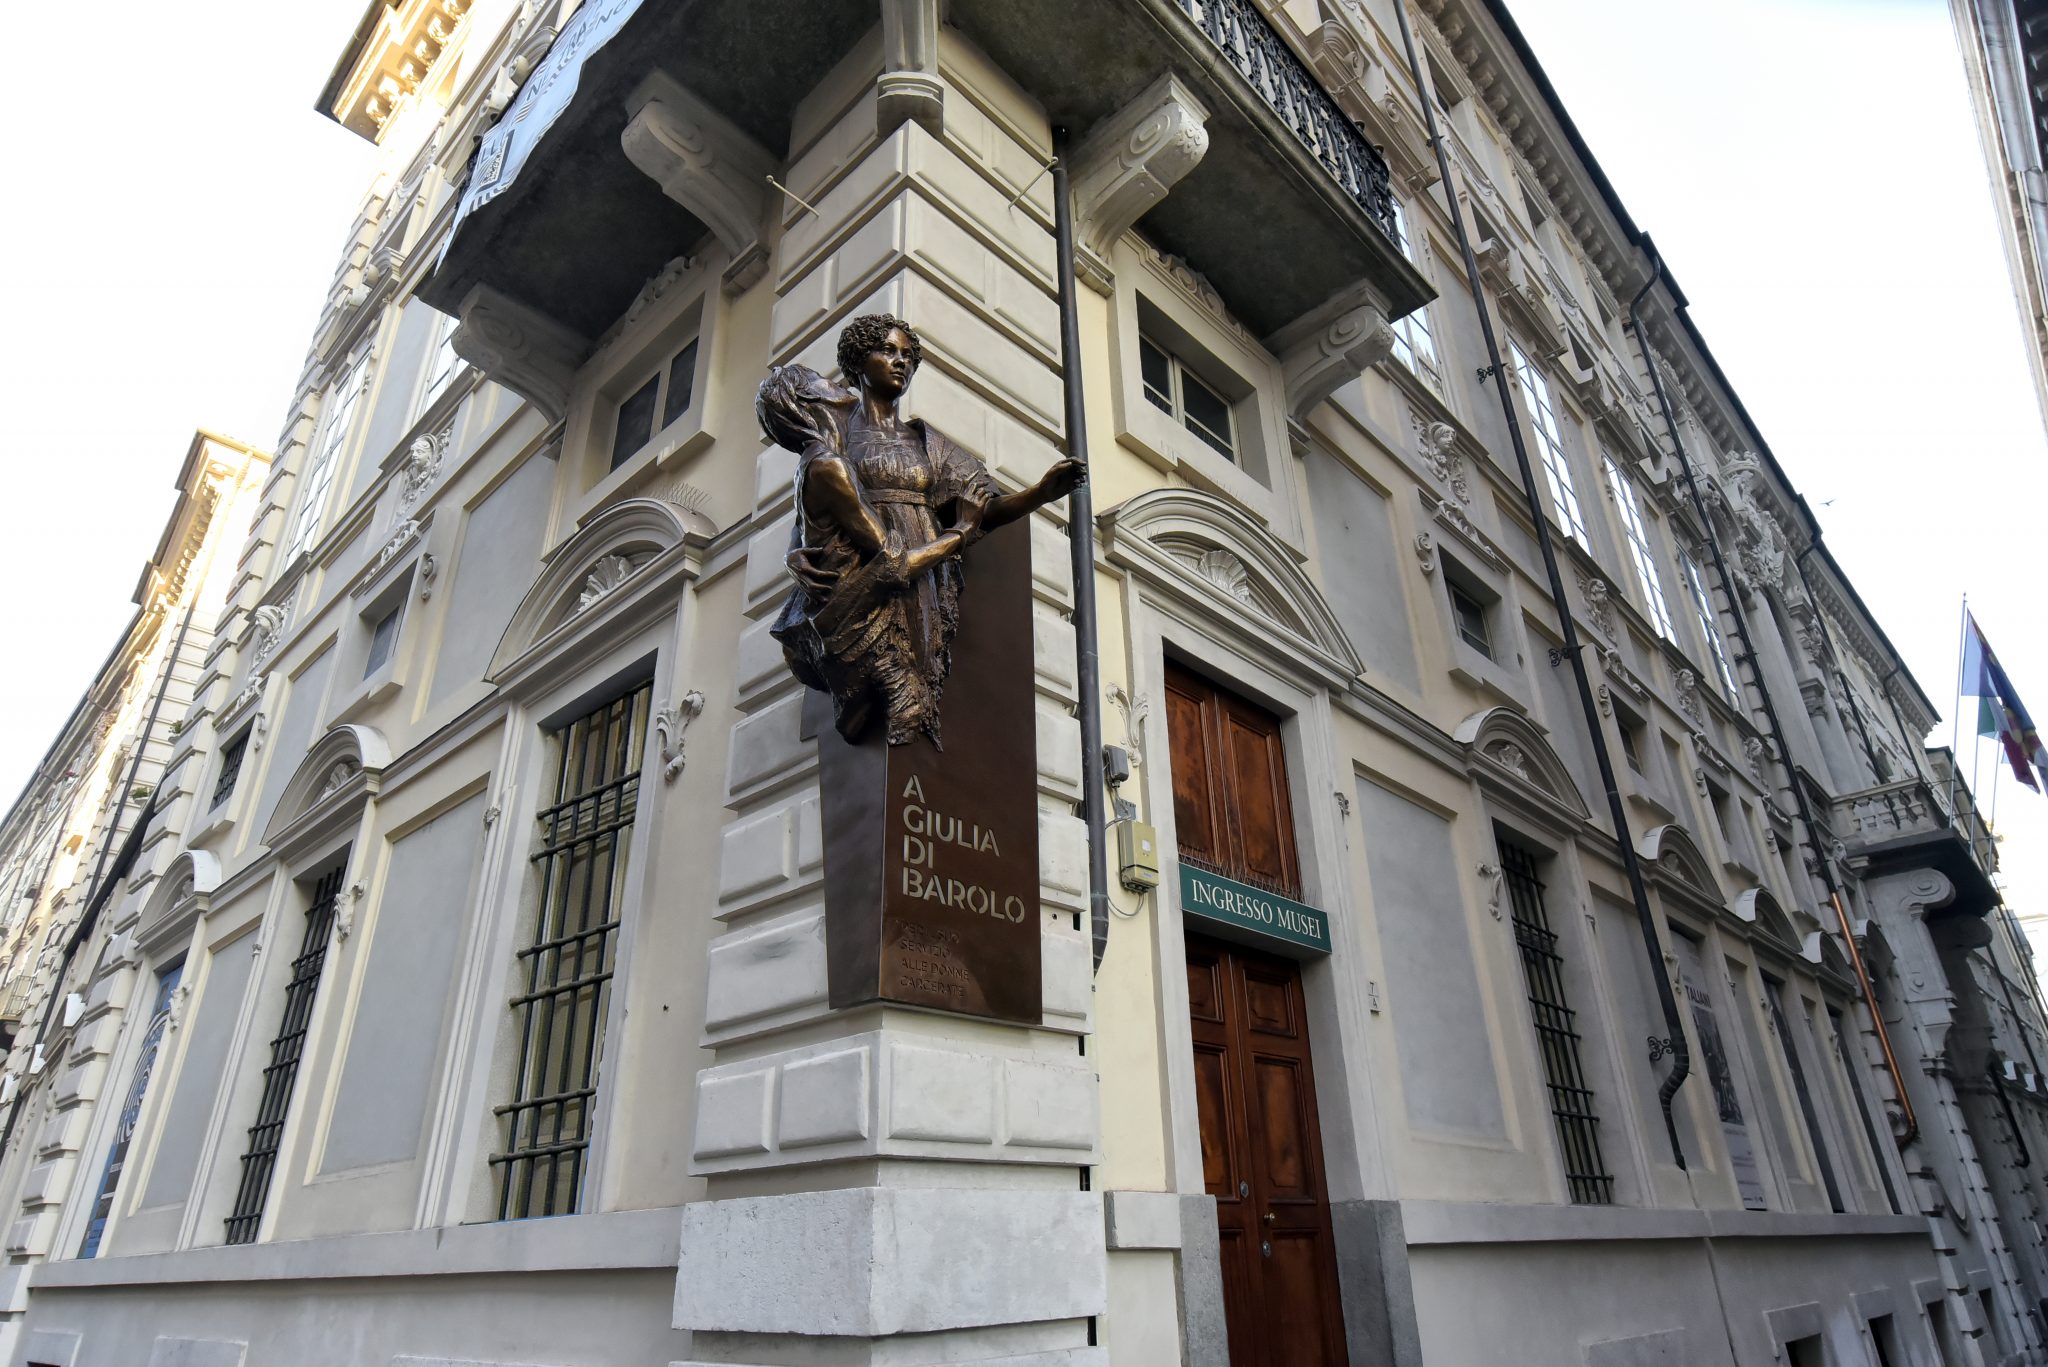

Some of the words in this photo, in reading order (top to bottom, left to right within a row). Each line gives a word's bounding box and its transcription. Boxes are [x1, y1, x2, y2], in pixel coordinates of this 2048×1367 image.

[902, 774, 926, 804] A
[903, 804, 1000, 857] GIULIA
[903, 834, 934, 869] DI
[902, 866, 1026, 924] BAROLO
[1192, 878, 1273, 924] INGRESSO
[1277, 906, 1322, 939] MUSEI
[900, 938, 952, 960] SERVIZIO
[901, 956, 928, 973] ALLE
[930, 962, 969, 981] DONNE
[900, 975, 967, 998] CARCERATE
